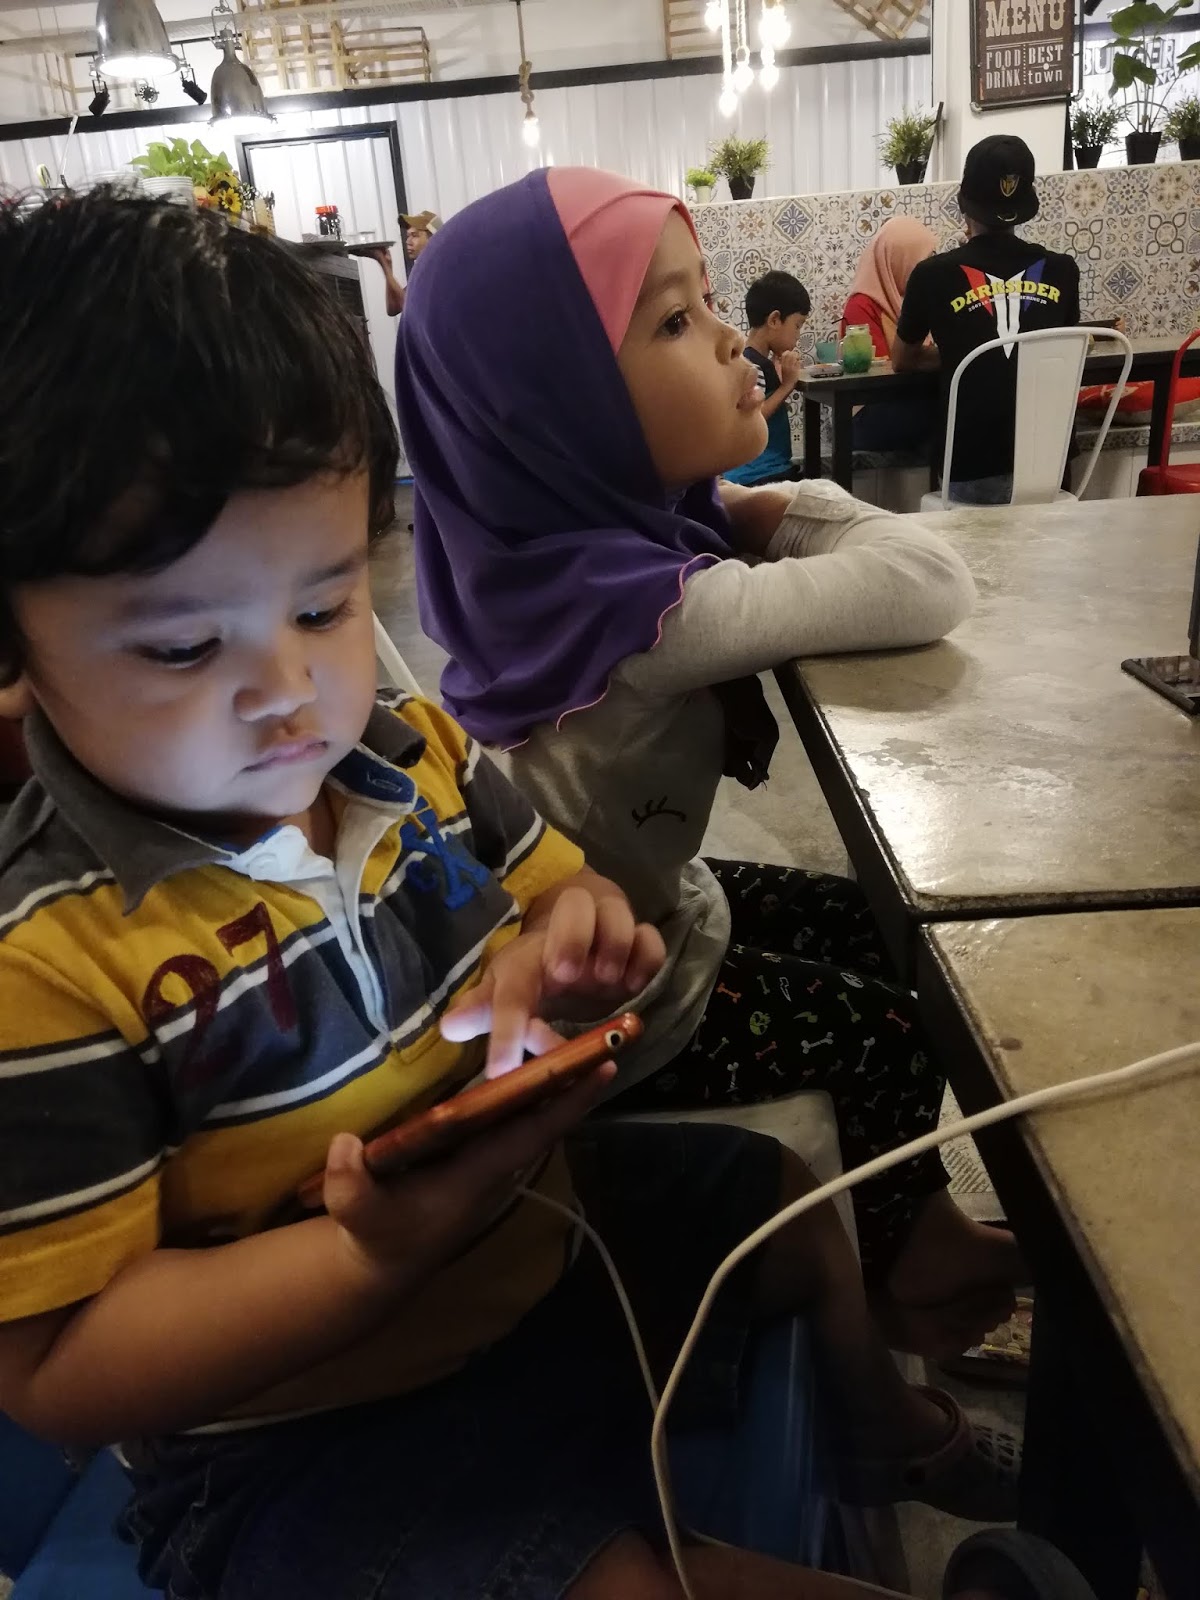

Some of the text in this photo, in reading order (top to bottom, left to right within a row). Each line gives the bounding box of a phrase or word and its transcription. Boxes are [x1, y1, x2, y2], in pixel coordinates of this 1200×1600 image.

[986, 0, 1066, 37] MENU
[986, 49, 1021, 69] FOOD
[1028, 44, 1063, 64] BEST
[986, 68, 1021, 89] DRINK
[1028, 69, 1063, 84] town
[950, 280, 1061, 313] DARKSIDER
[141, 900, 300, 1093] 97
